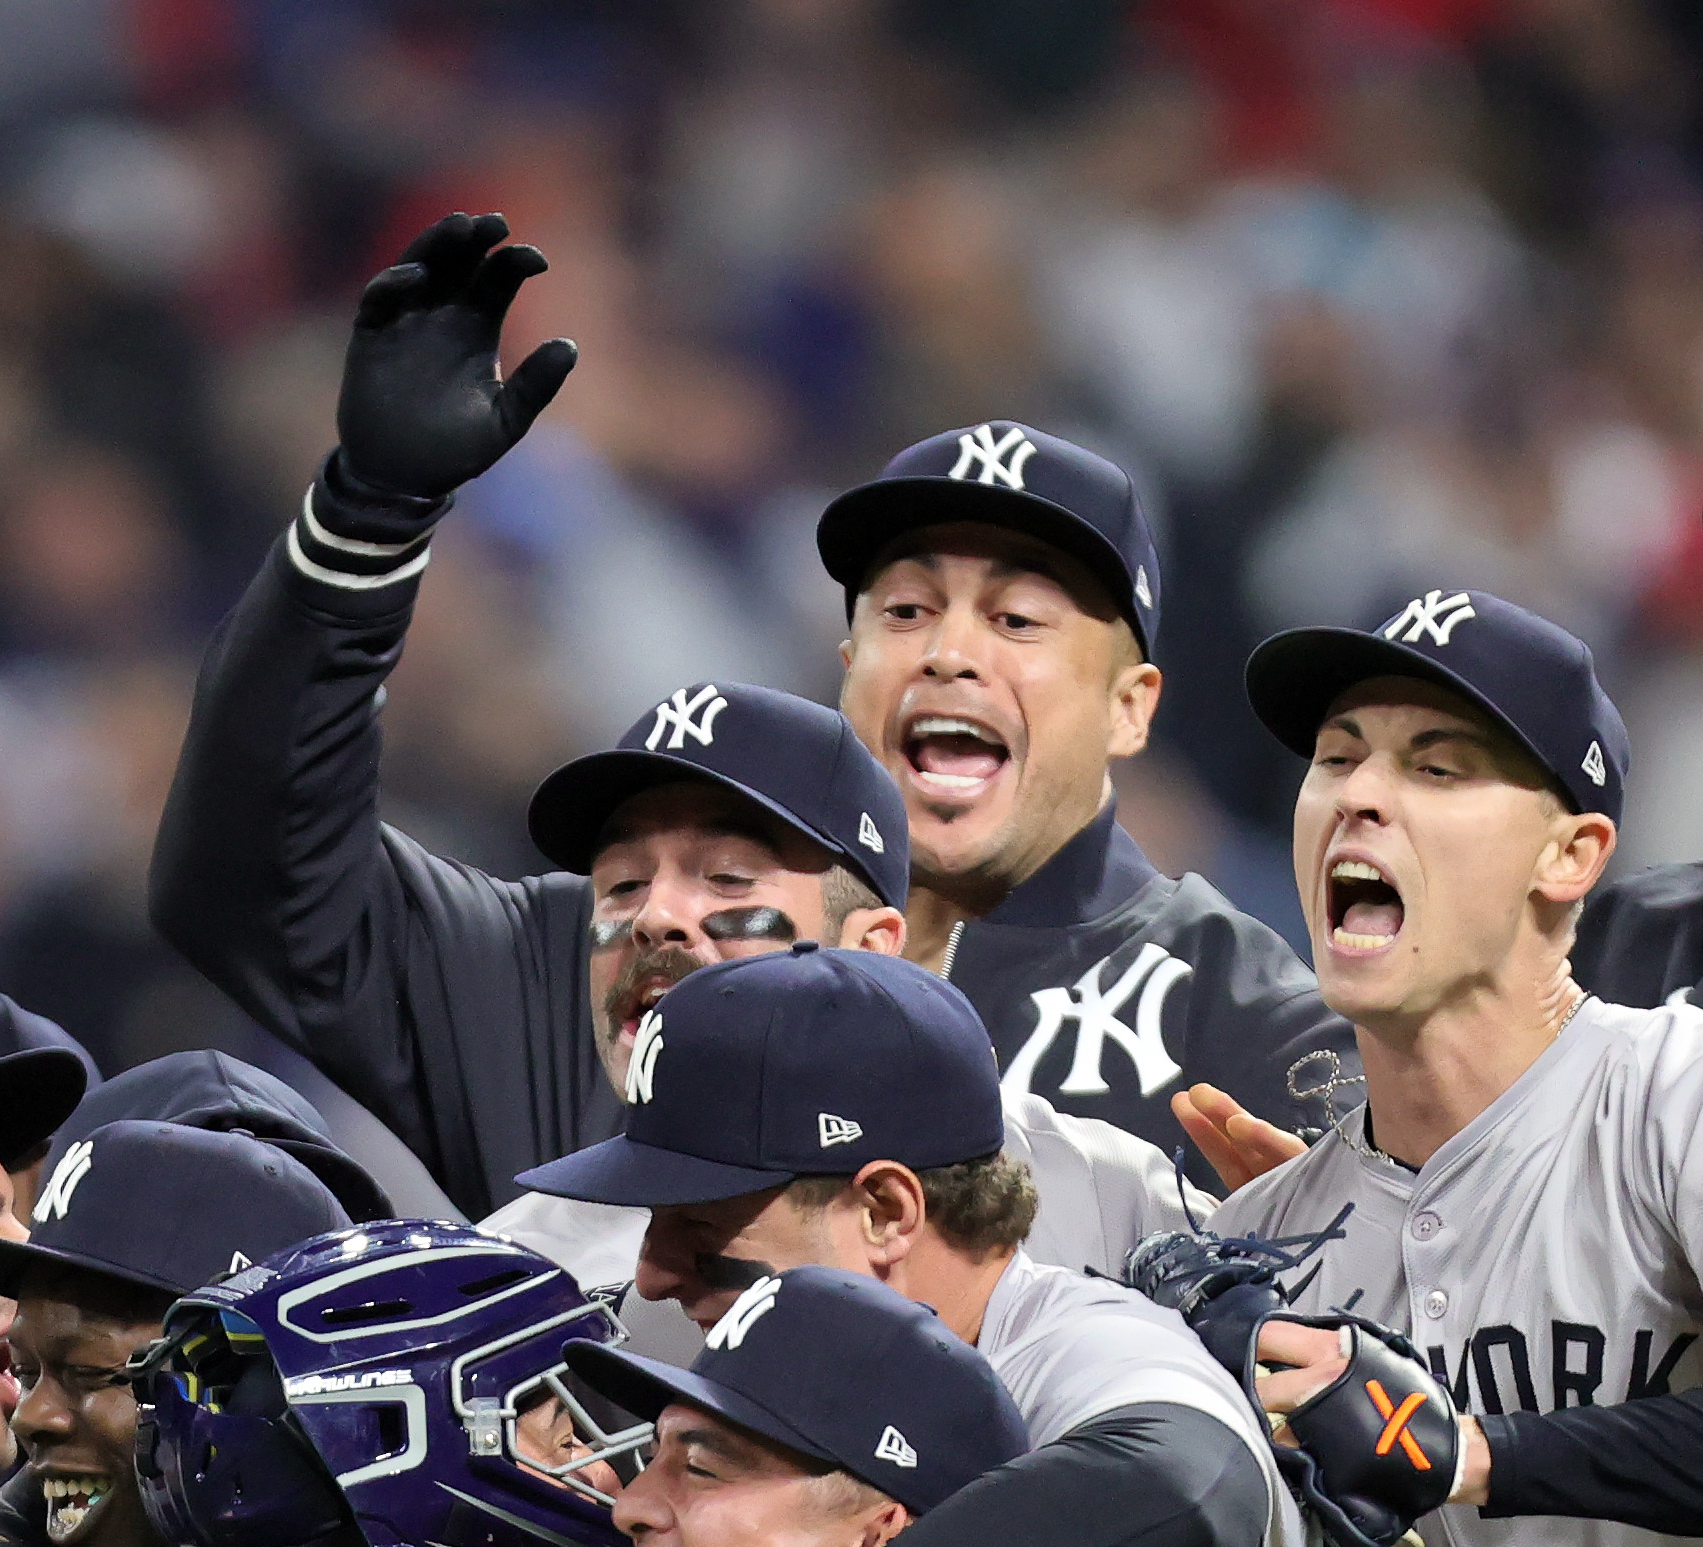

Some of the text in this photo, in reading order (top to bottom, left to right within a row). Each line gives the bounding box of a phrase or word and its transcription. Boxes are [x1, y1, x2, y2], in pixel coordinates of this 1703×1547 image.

[949, 424, 1036, 492] NY
[1386, 590, 1476, 647] NY
[646, 684, 728, 751] NY
[1000, 942, 1194, 1098] NY
[1427, 1319, 1699, 1415] YORK
